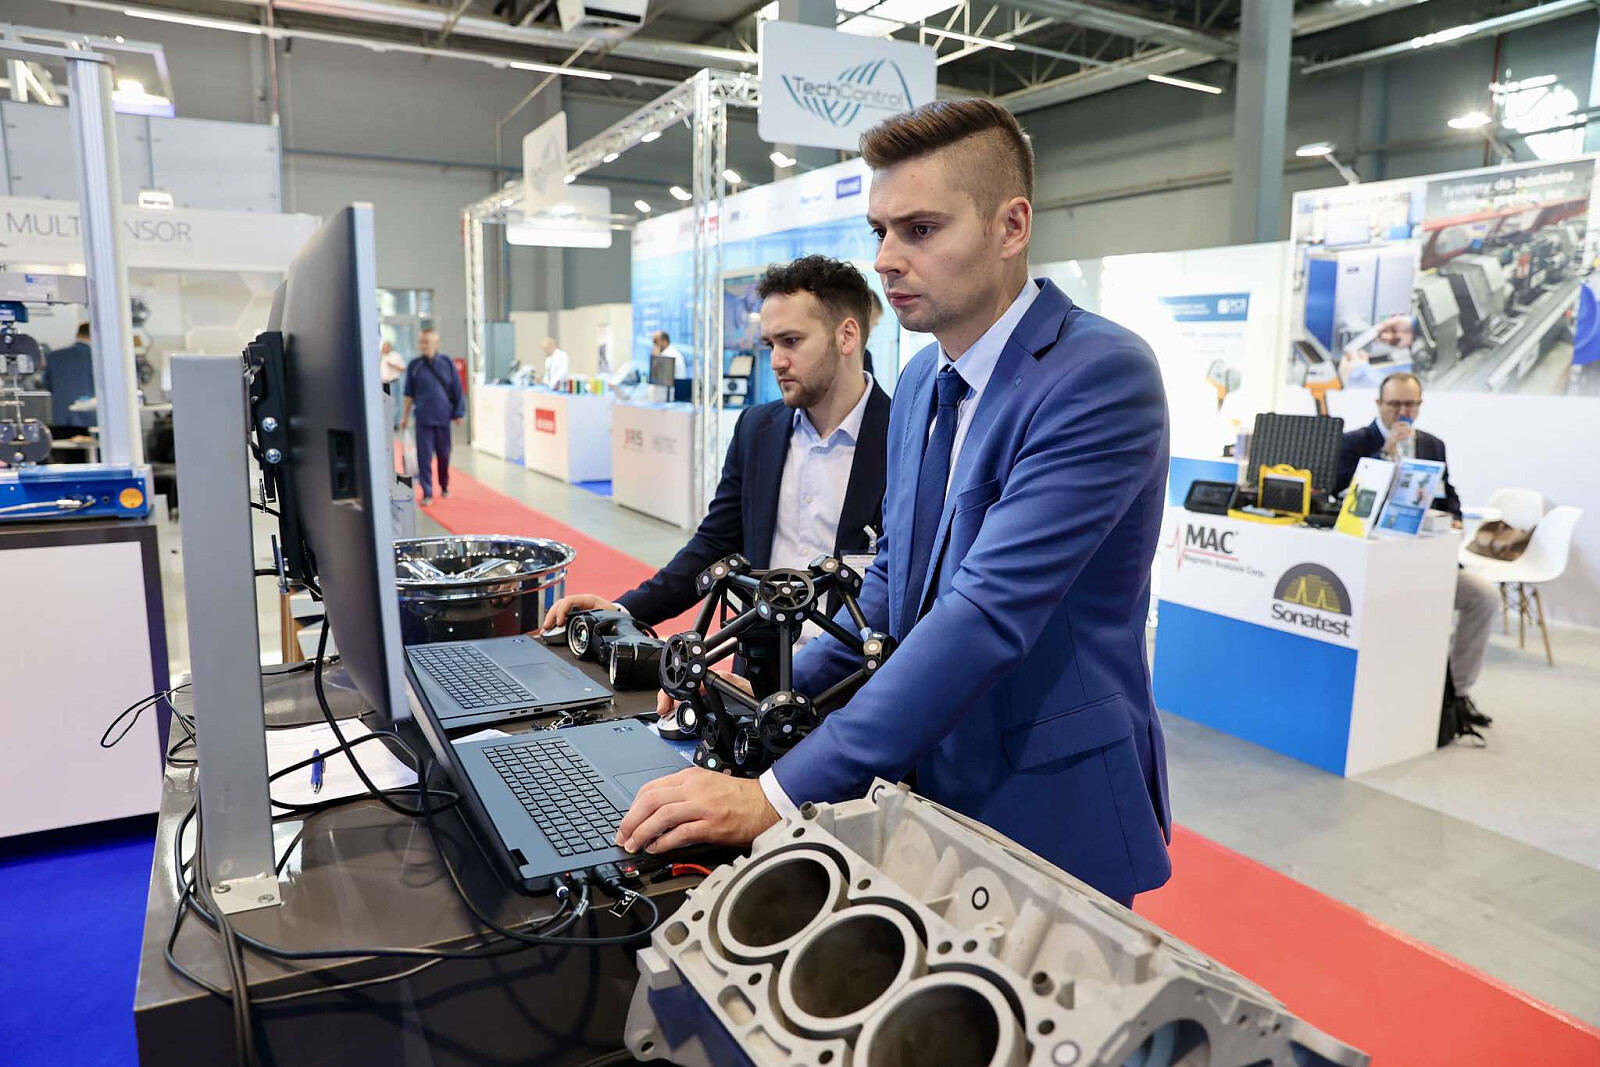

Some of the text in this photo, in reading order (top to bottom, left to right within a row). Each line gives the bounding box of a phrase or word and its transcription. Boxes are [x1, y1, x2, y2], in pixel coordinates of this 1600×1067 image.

[792, 75, 904, 107] TechControl
[1185, 524, 1235, 555] MAC
[1271, 603, 1351, 639] Sonatest
